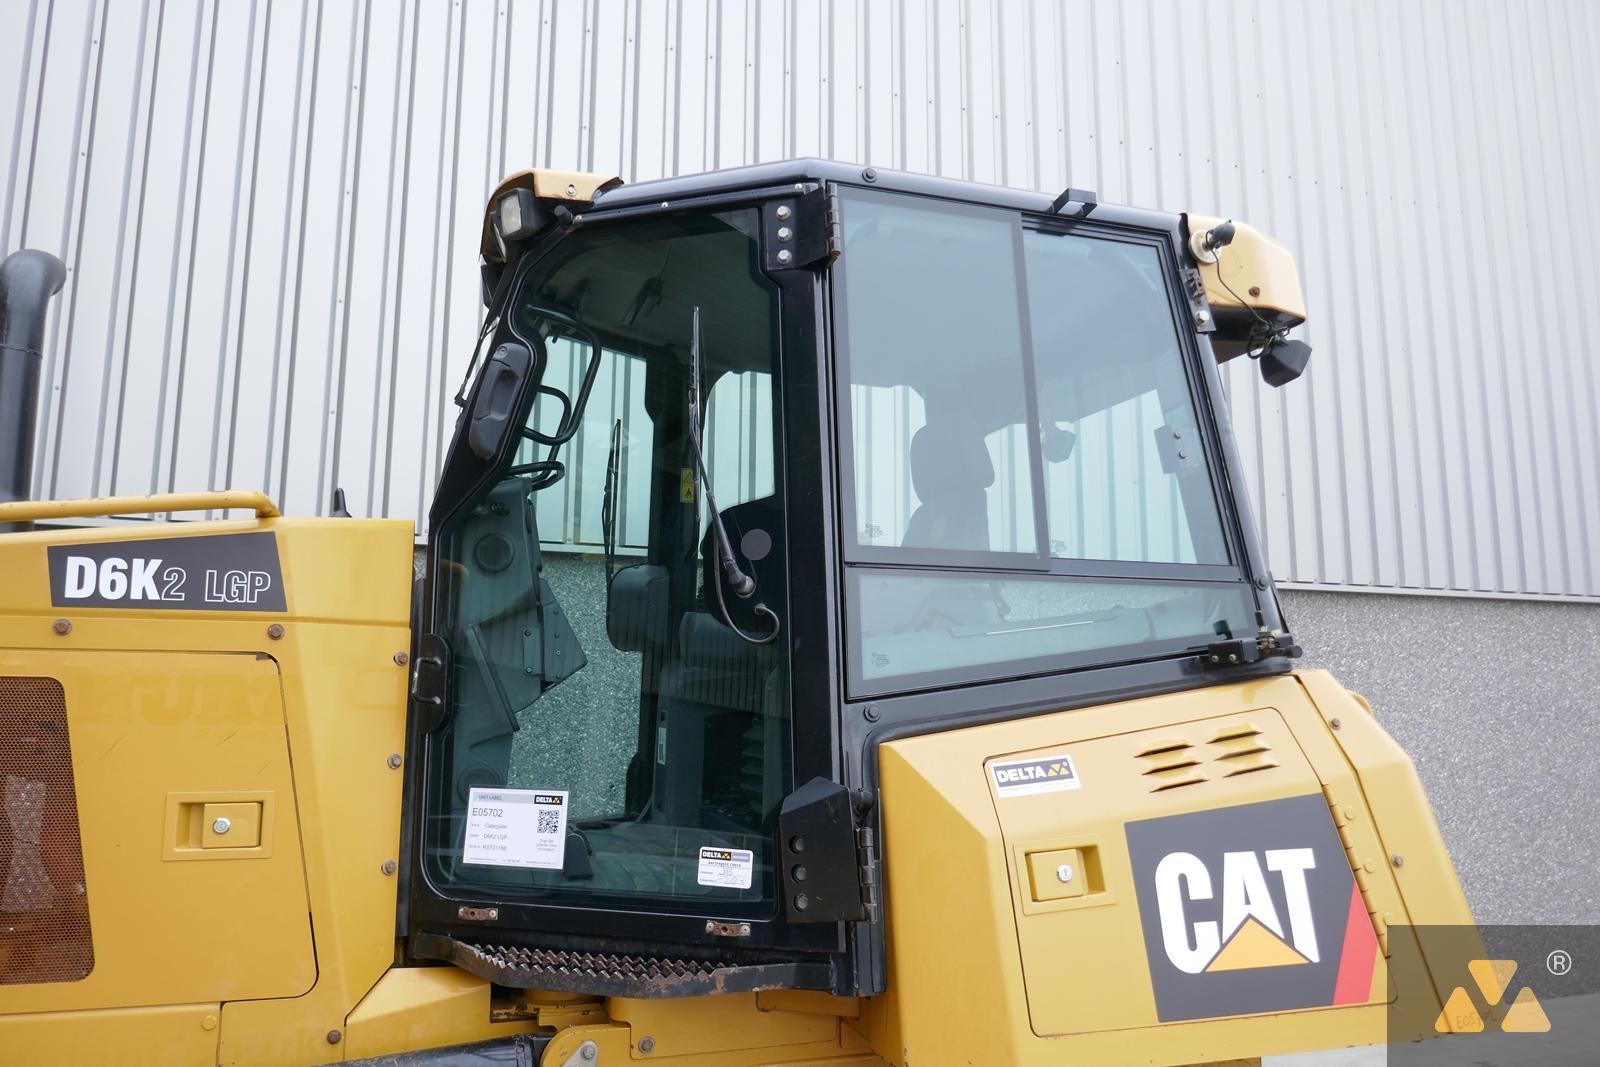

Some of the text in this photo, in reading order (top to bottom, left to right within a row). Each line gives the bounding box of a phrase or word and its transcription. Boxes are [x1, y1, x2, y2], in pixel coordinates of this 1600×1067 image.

[204, 569, 272, 603] LGP
[995, 765, 1048, 783] DELTA
[472, 807, 503, 817] E05702
[1154, 847, 1321, 974] CAT
